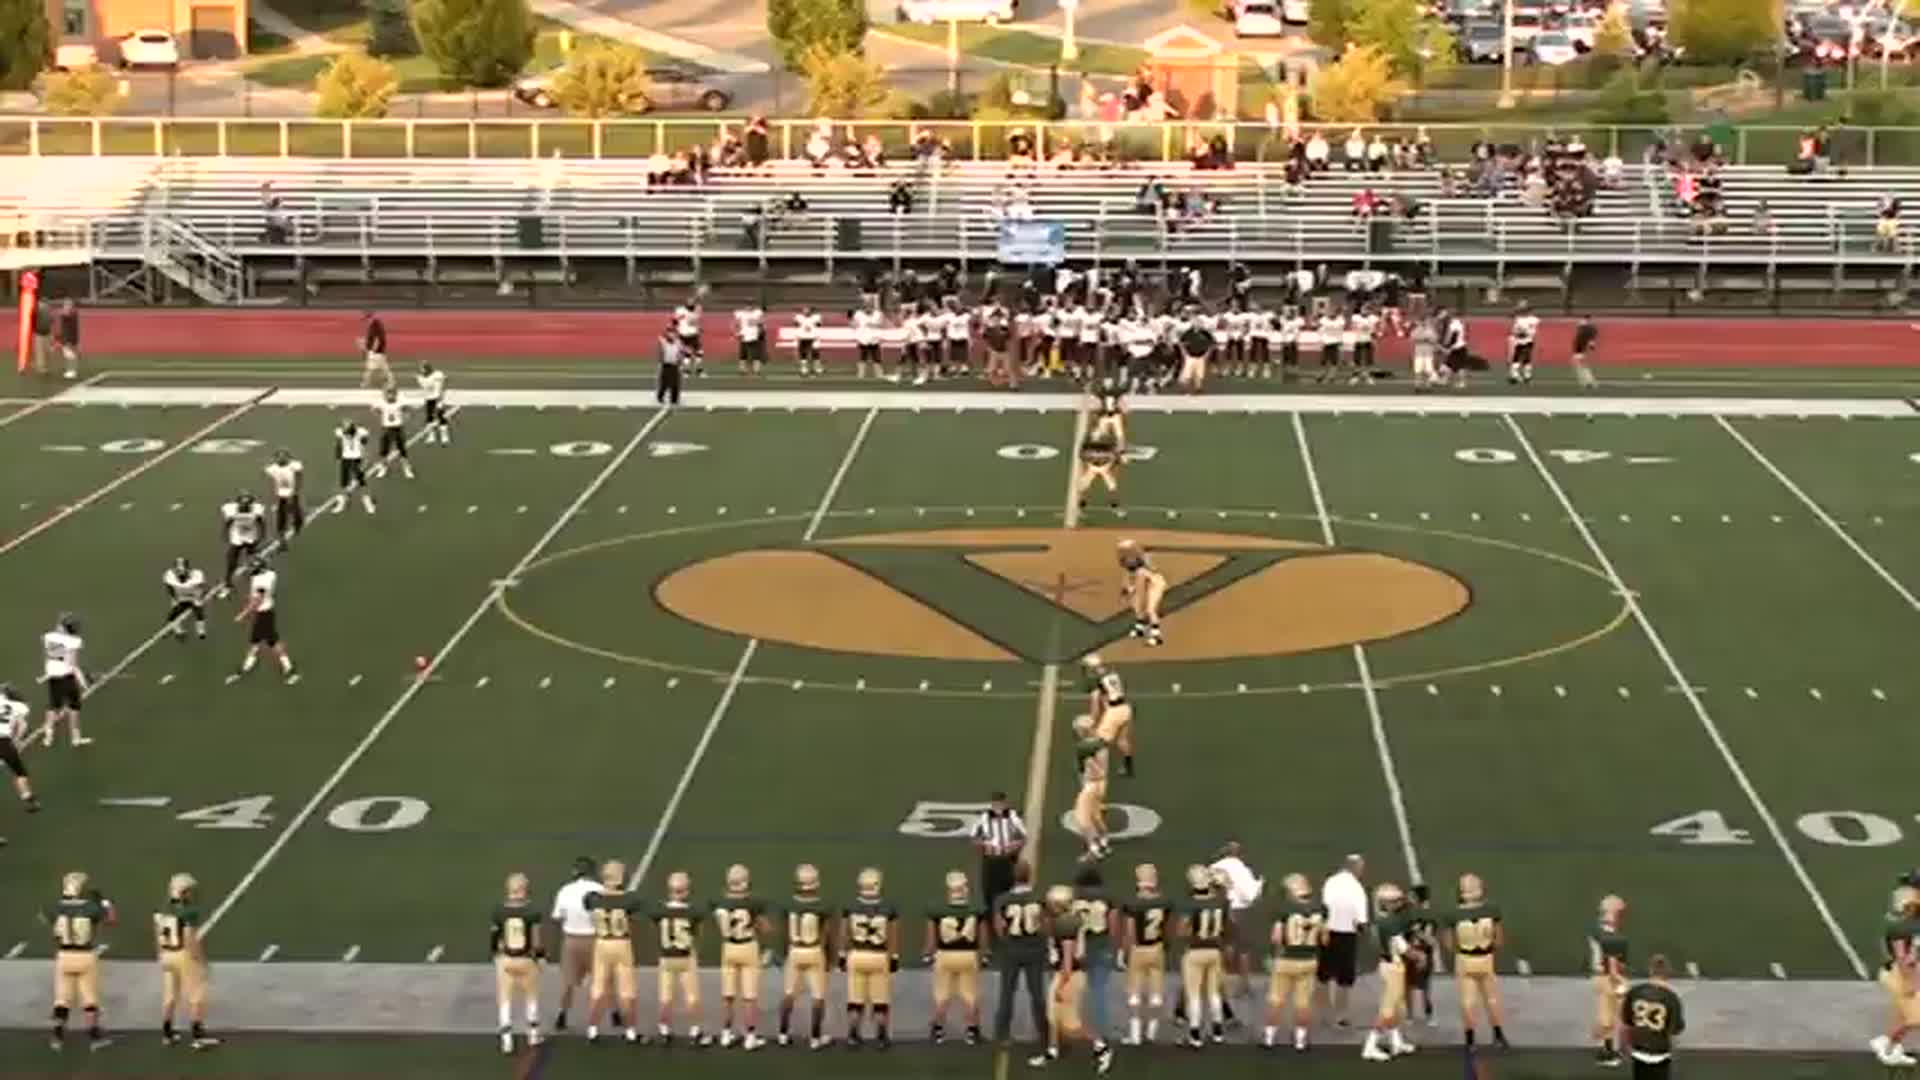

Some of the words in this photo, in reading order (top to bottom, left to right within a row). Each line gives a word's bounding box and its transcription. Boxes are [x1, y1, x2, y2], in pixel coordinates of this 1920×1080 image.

[176, 795, 431, 829] 40
[897, 801, 1162, 838] 50
[1650, 809, 1904, 847] 40
[659, 917, 693, 950] 15
[714, 908, 753, 941] 12
[1144, 908, 1165, 941] 2
[1198, 909, 1223, 939] 11
